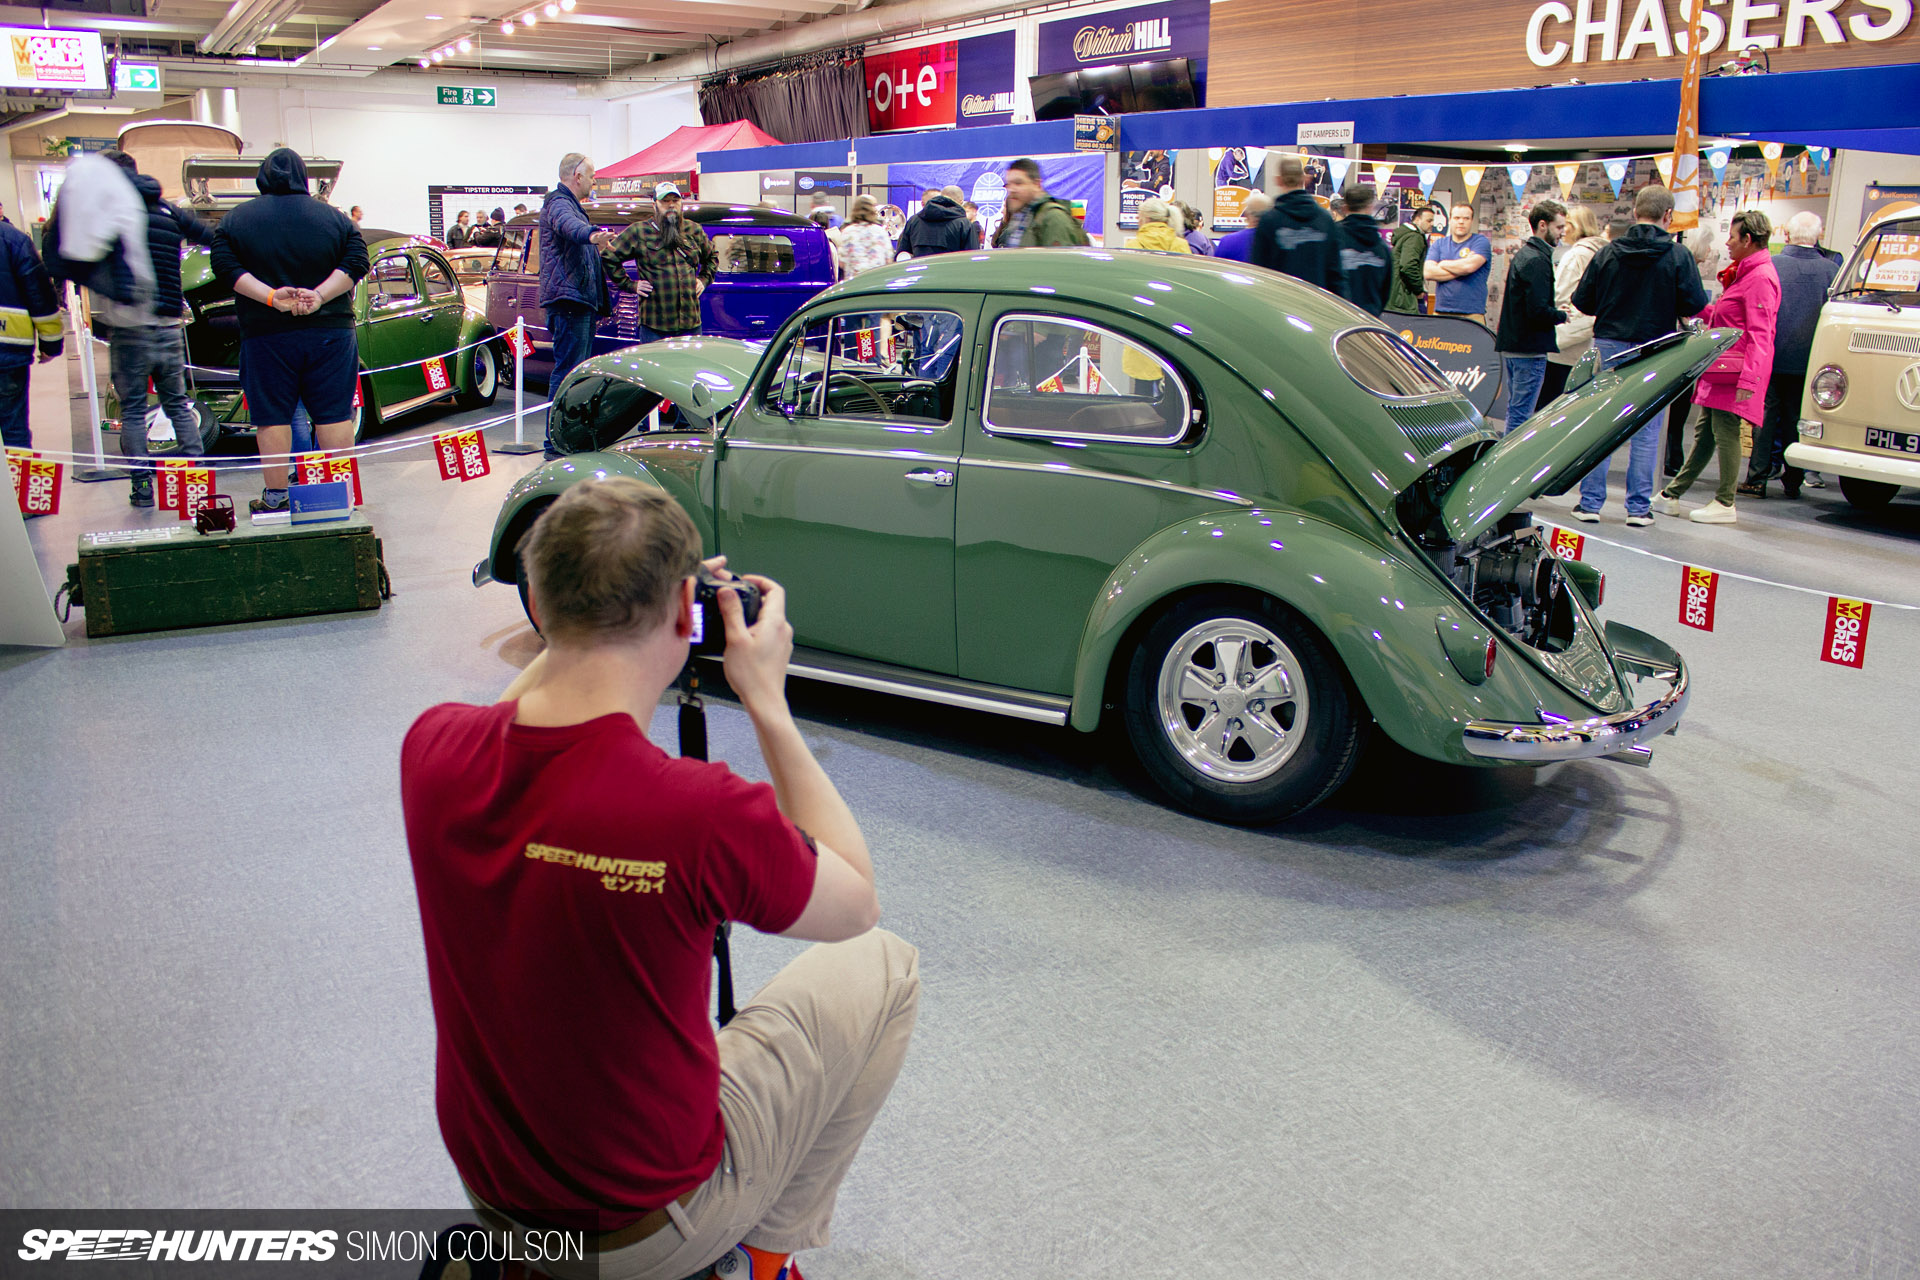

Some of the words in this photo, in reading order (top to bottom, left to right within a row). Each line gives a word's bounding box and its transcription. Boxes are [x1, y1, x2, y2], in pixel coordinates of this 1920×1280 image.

[1073, 23, 1135, 60] William
[1134, 17, 1171, 50] HILL
[1526, 0, 1912, 67] CHASERS
[443, 88, 458, 96] Fire
[443, 96, 458, 104] exit
[867, 65, 937, 112] ote
[961, 94, 994, 116] William
[994, 92, 1015, 111] HILL
[1300, 130, 1312, 139] JUST
[1313, 129, 1339, 138] KAMPERS
[1340, 128, 1351, 138] LTD
[1881, 192, 1918, 200] JustKampers
[1880, 243, 1919, 255] HELP
[1414, 336, 1472, 354] JustKampers
[428, 361, 440, 389] WORLD
[434, 360, 446, 388] VOLKS
[460, 436, 475, 477] WORLD
[469, 433, 485, 475] VOLKS
[1866, 429, 1901, 450] PHL
[27, 464, 42, 510] WORLD
[39, 465, 55, 511] VOLKS
[186, 473, 198, 517] WORLD
[197, 473, 208, 510] VOLK
[1686, 571, 1701, 623] WORLD
[1695, 574, 1711, 626] VOLKS
[1831, 603, 1850, 660] WORLD
[1842, 605, 1862, 662] VOLKS
[525, 842, 667, 878] SPEEDHUNTERS
[600, 875, 666, 894] ゼンカイ
